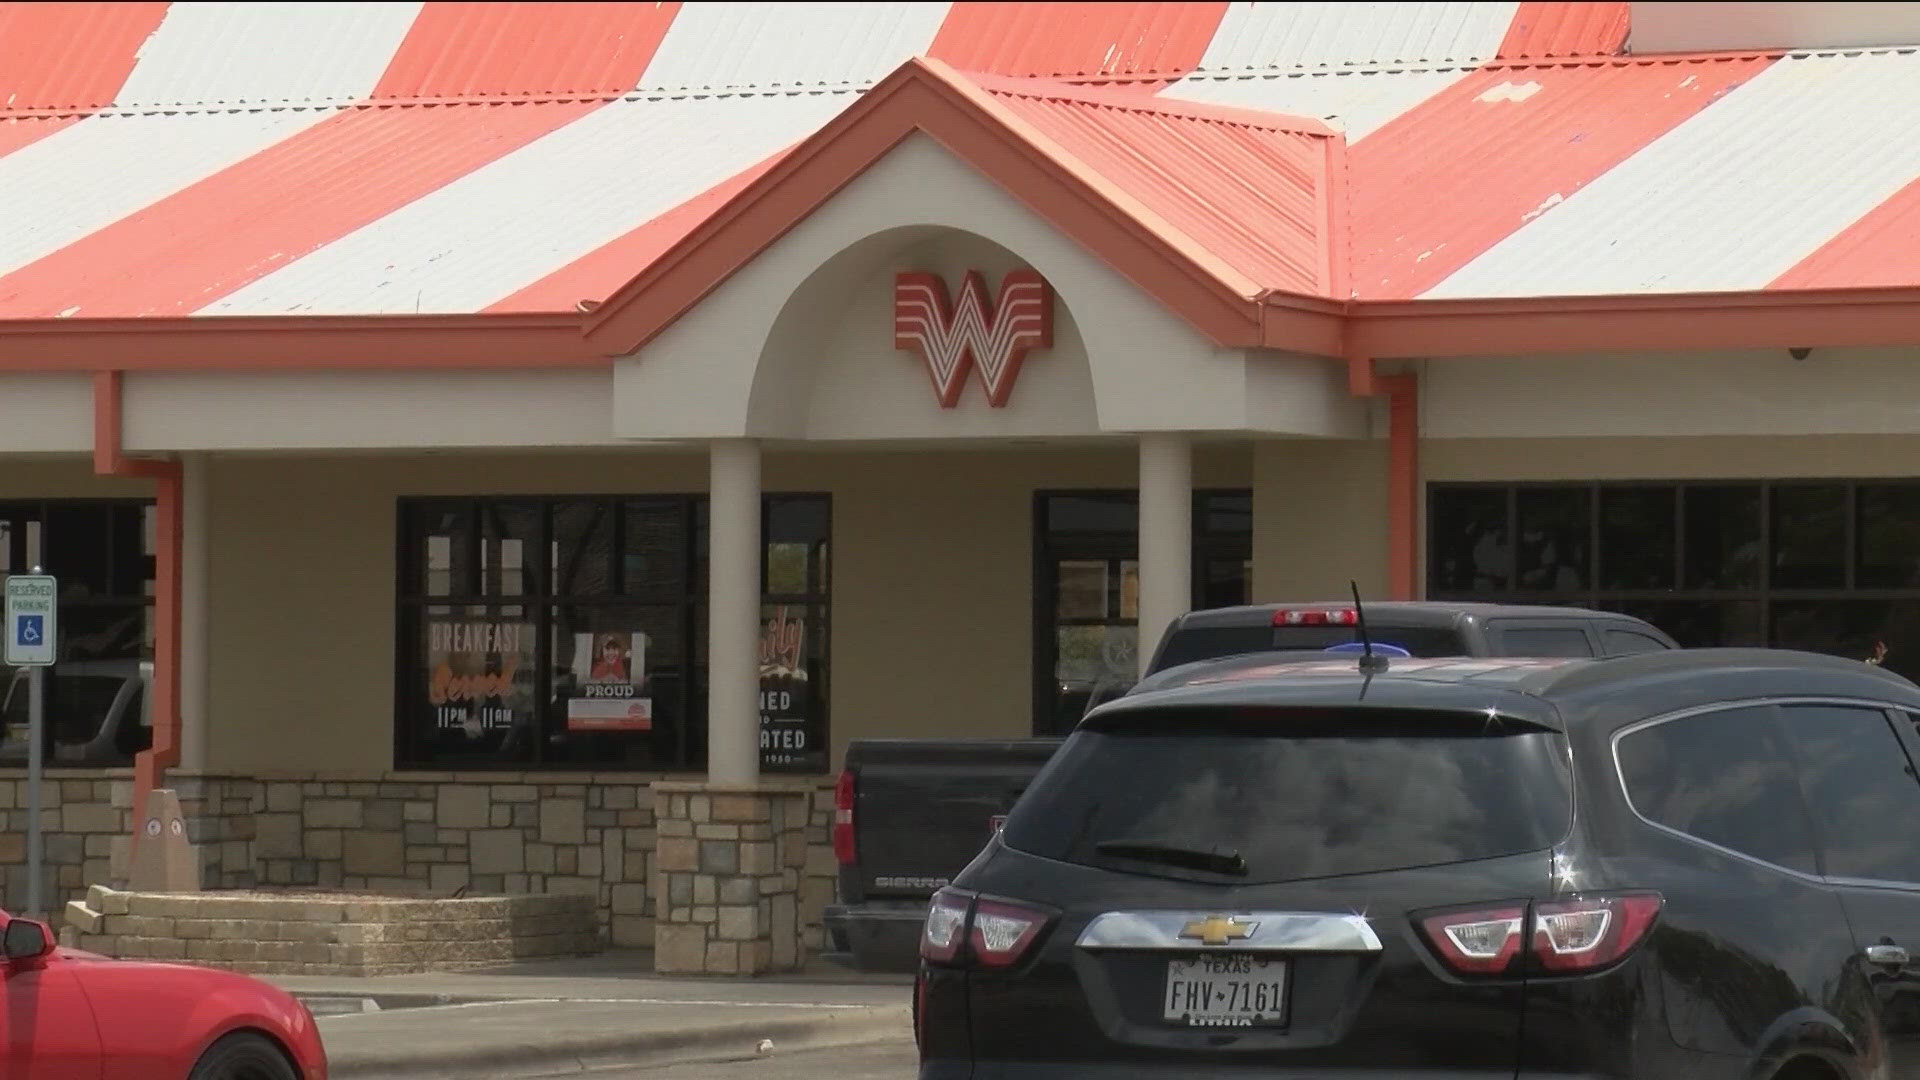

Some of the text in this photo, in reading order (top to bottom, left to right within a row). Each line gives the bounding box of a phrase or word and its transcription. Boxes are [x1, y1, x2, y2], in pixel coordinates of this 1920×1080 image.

[895, 269, 1054, 409] W
[9, 585, 52, 596] RESERVED
[12, 600, 49, 611] PARKING
[432, 623, 519, 652] BREAKFAST
[759, 605, 803, 672] ily
[585, 685, 634, 697] PROUD
[760, 729, 805, 749] ATED
[875, 877, 949, 888] SIERRA
[1204, 961, 1251, 974] TEXAS
